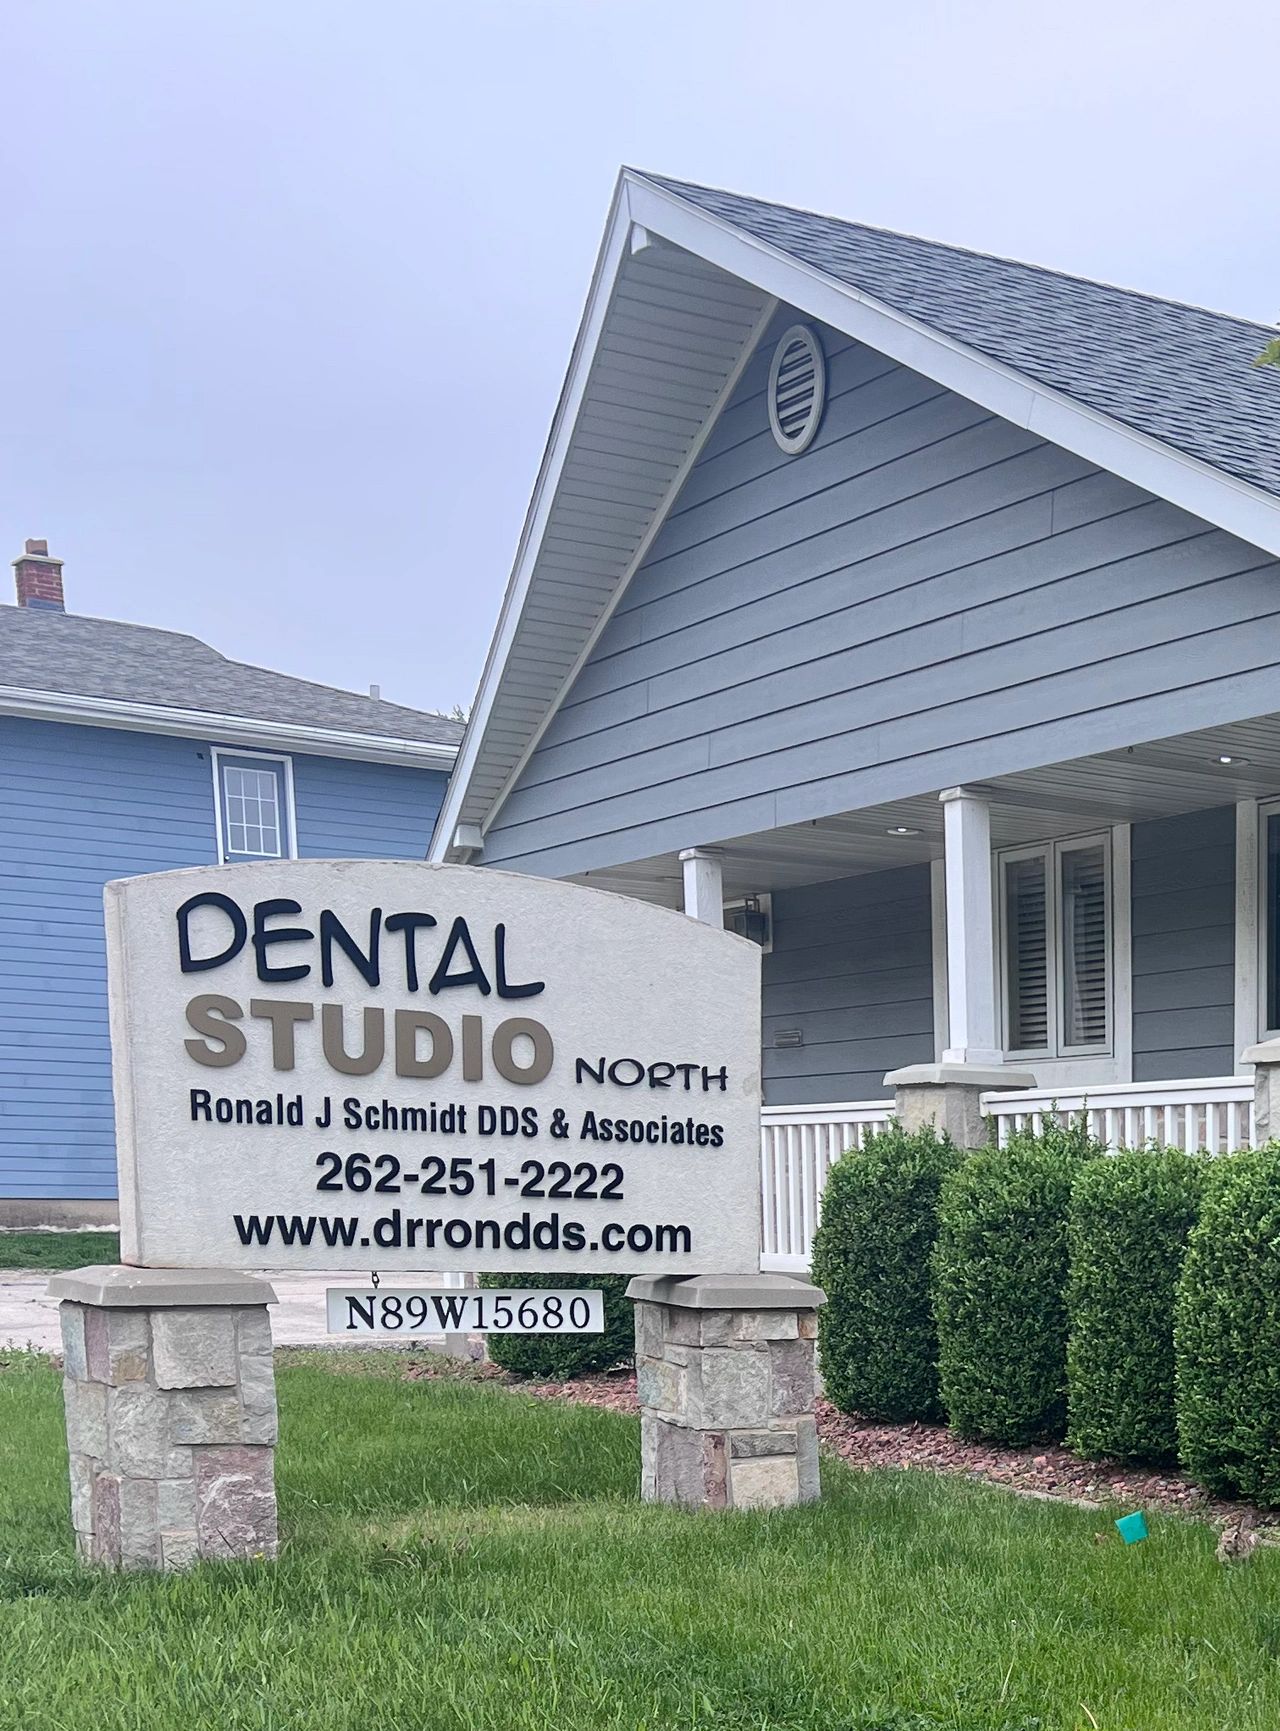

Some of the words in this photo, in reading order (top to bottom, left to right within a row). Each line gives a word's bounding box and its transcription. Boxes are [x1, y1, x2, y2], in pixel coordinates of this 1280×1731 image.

[176, 892, 545, 999] DENTAL
[184, 994, 554, 1085] STUDIO
[576, 1057, 728, 1091] NORTH
[190, 1089, 303, 1126] Ronald
[316, 1097, 330, 1128] J
[344, 1098, 466, 1134] Schmidt
[478, 1105, 538, 1138] DDS
[550, 1109, 569, 1139] &
[580, 1111, 723, 1147] Associates
[316, 1152, 623, 1200] 262-251-2222
[233, 1209, 691, 1253] www.drrondds.com
[345, 1296, 589, 1329] N89W15680
